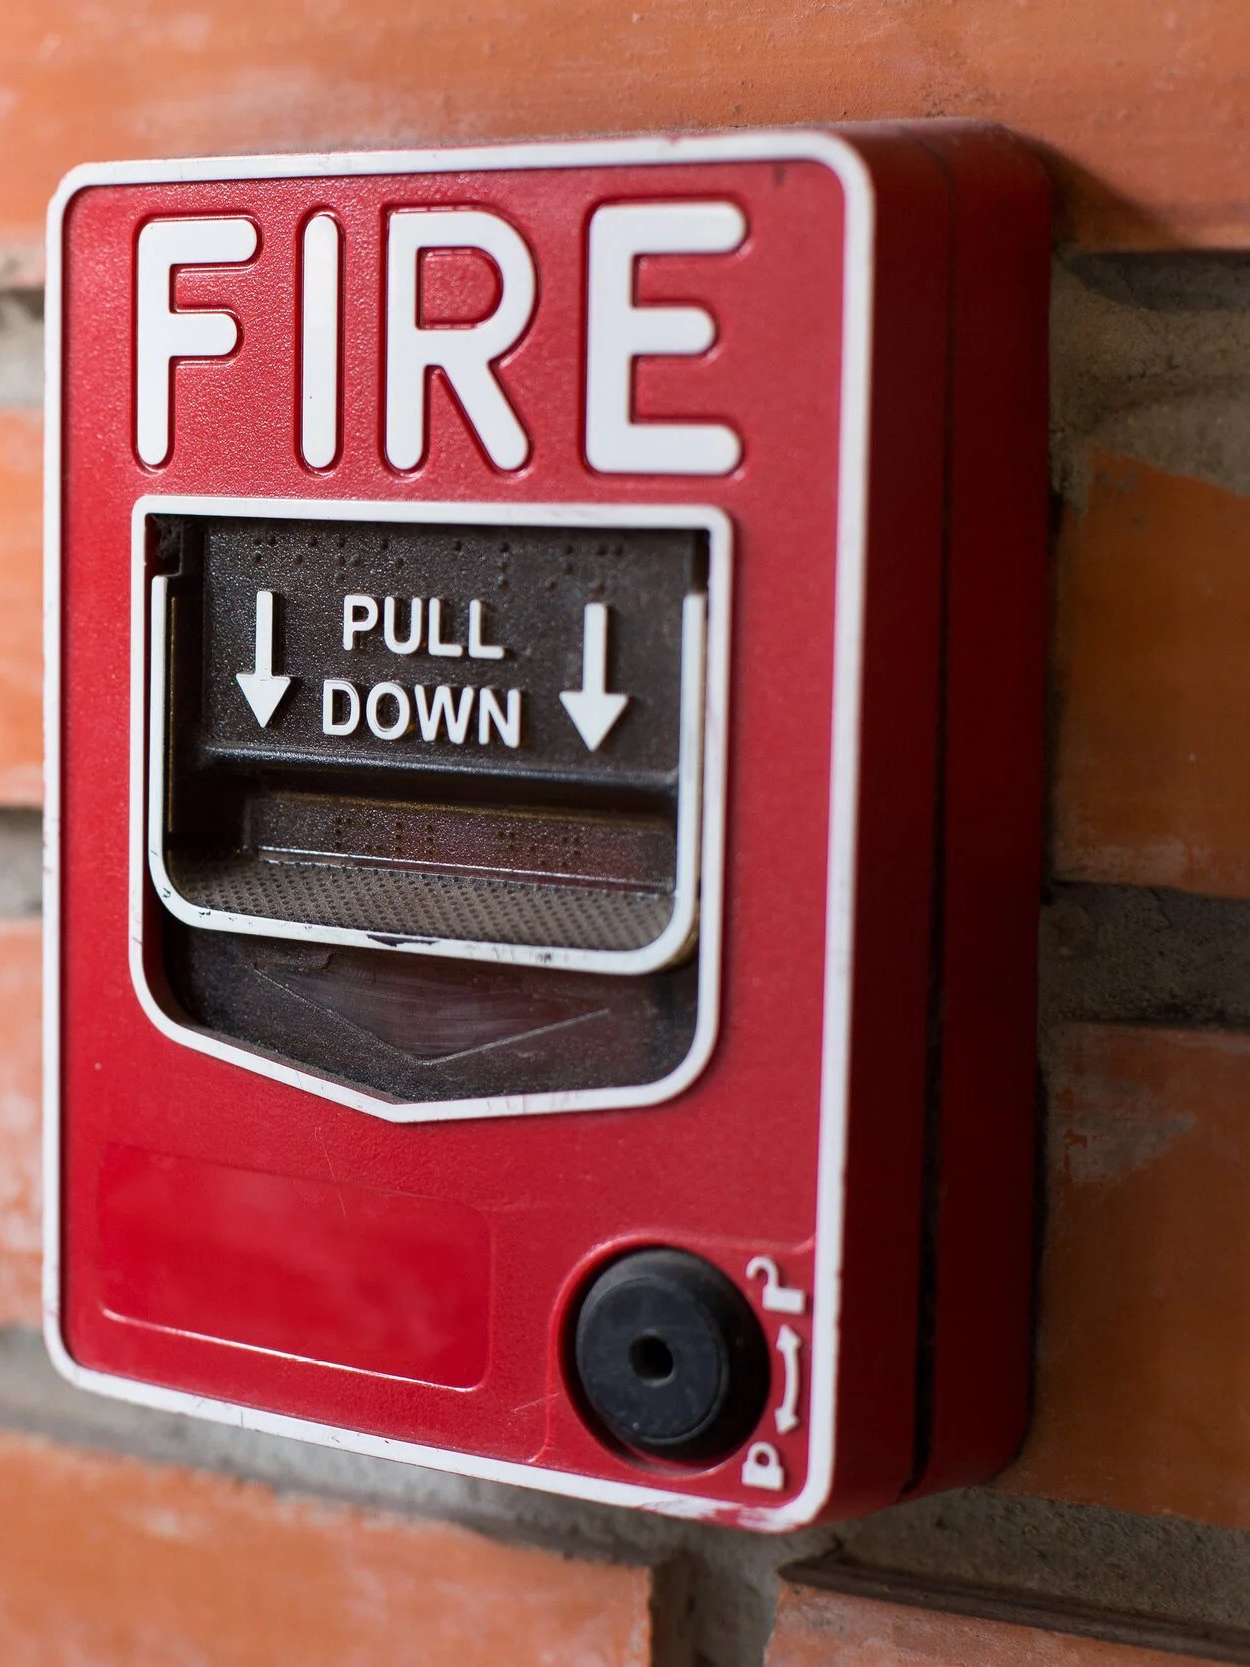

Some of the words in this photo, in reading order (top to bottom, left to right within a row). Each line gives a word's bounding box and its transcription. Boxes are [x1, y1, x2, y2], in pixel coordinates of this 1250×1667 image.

[136, 202, 746, 475] FIRE
[342, 594, 505, 659] PULL
[321, 678, 522, 749] DOWN
